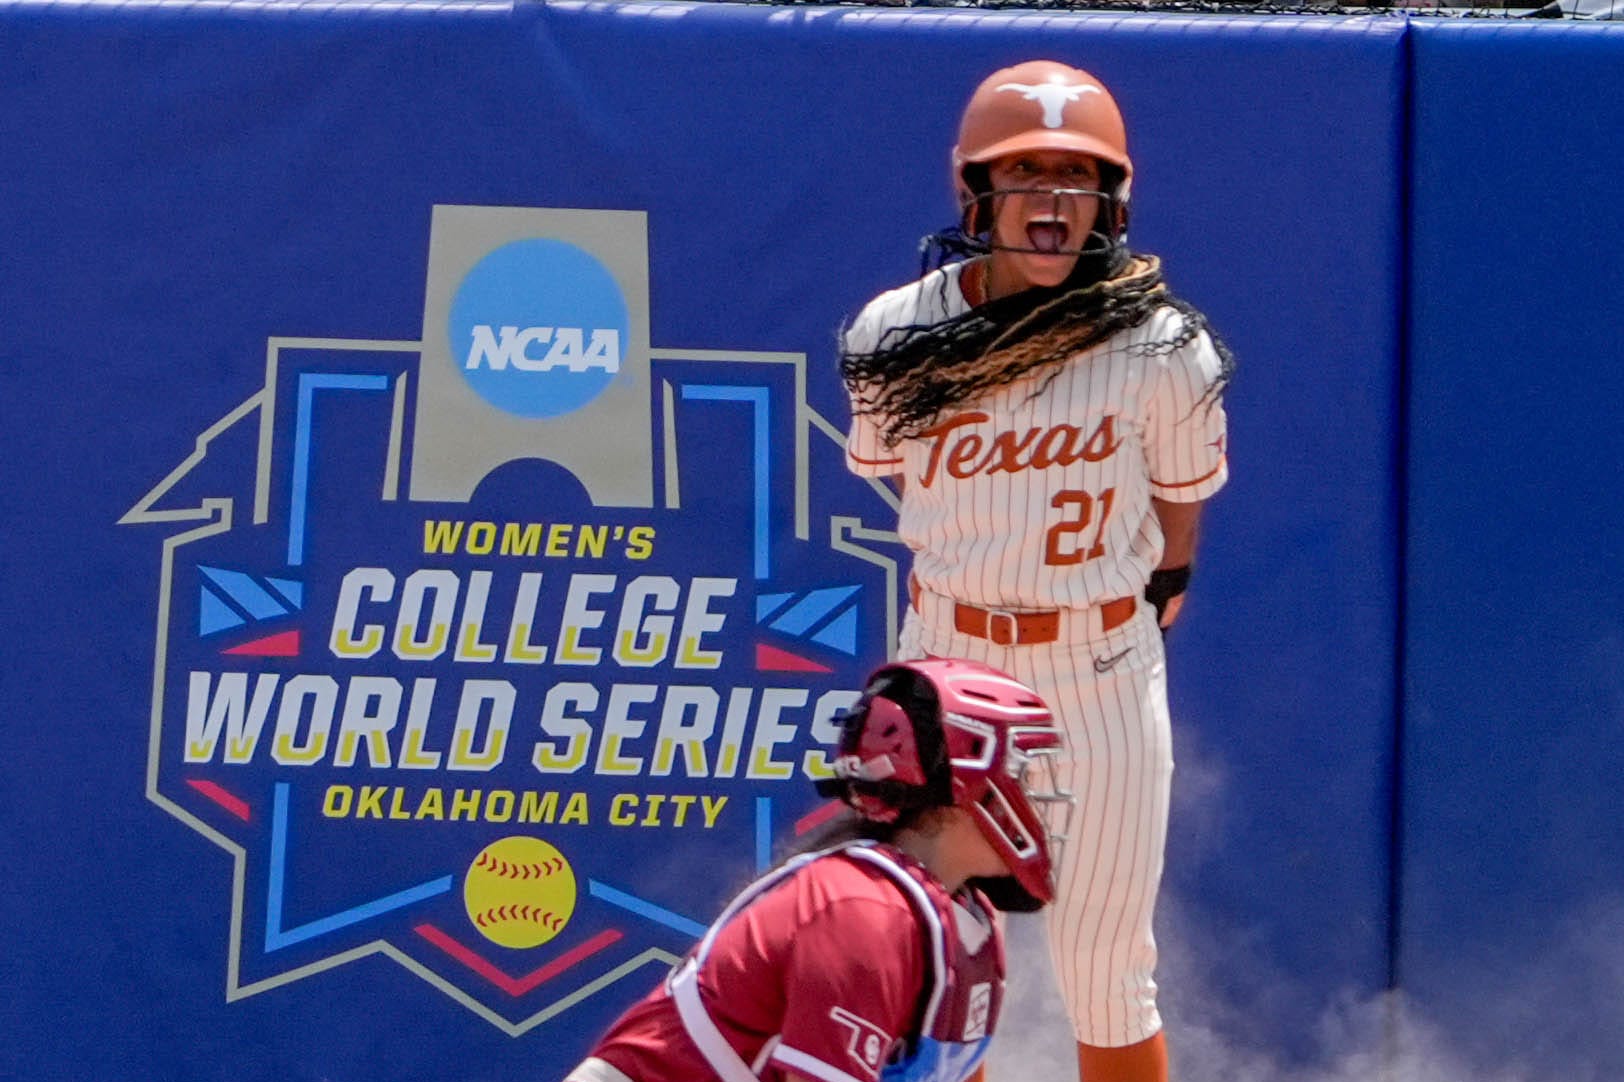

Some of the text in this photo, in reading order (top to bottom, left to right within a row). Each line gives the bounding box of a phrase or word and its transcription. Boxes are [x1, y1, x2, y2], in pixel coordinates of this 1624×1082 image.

[465, 324, 620, 374] NCAA
[917, 410, 1125, 489] Texas
[423, 519, 657, 560] WOMEN'S
[1045, 487, 1116, 567] 21
[328, 566, 738, 670] COLLEGE
[183, 670, 862, 782] WORLD SERIES
[322, 784, 729, 829] OKLAHOMA CITY
